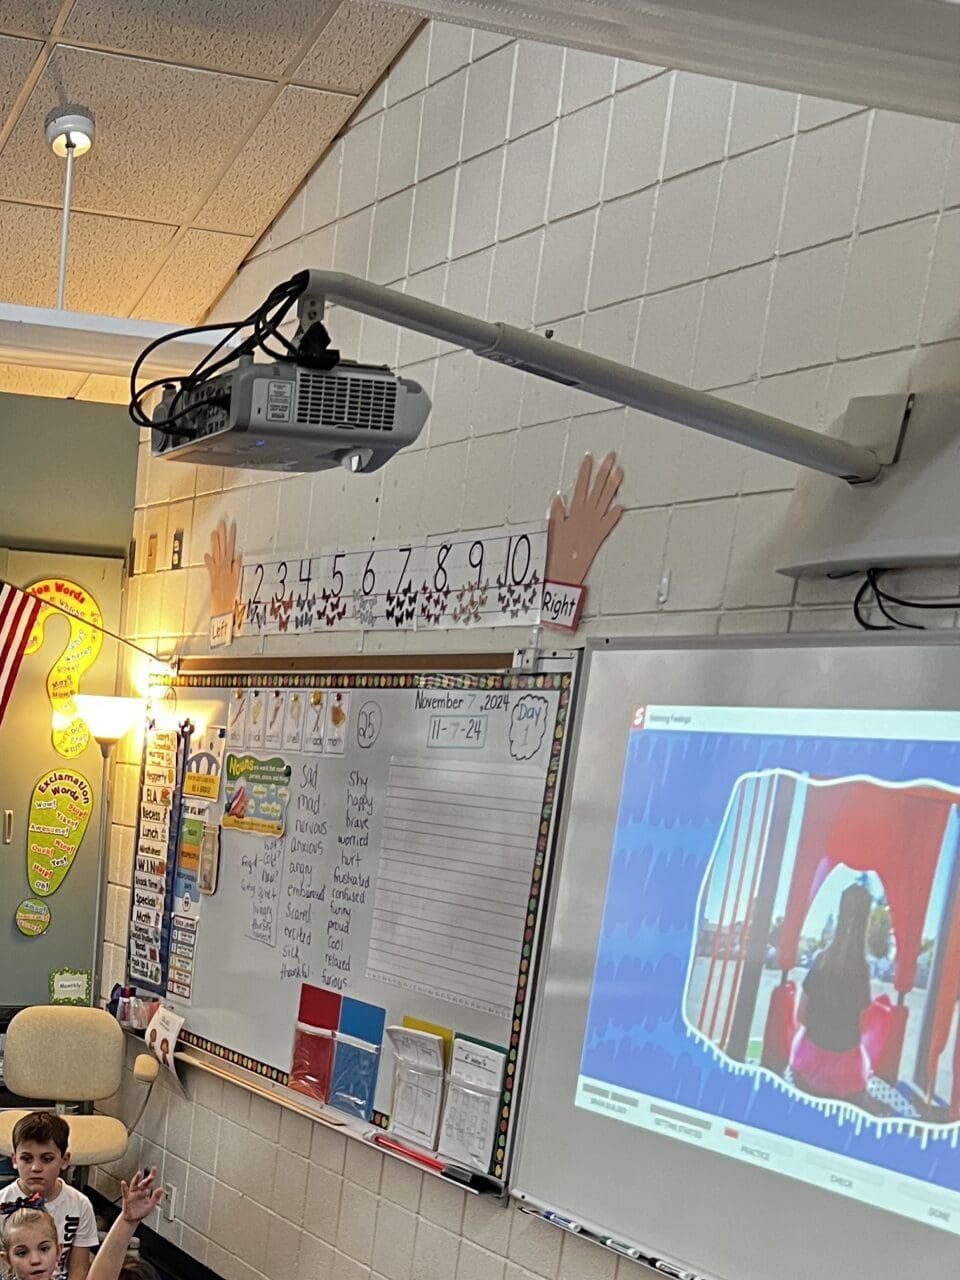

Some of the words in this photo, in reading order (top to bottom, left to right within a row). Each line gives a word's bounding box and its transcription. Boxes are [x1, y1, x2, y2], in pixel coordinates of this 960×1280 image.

[252, 563, 264, 604] 2
[274, 561, 288, 602] 3
[299, 558, 312, 601] 4
[331, 553, 346, 598] 5
[362, 551, 376, 596] 6
[395, 547, 412, 594] 7
[433, 543, 452, 592] 8
[468, 540, 484, 590] 9
[504, 534, 531, 586] 10
[54, 581, 87, 605] Words
[543, 590, 576, 620] Right
[212, 619, 228, 640] Left
[414, 690, 464, 711] November
[358, 709, 376, 740] 25
[518, 703, 542, 728] Day
[38, 772, 90, 805] Exclamation
[51, 785, 80, 802] Words
[146, 787, 158, 804] ELA
[297, 793, 321, 816] mad
[346, 789, 374, 816] happy
[142, 805, 161, 822] Recess
[345, 810, 369, 830] brave
[142, 826, 159, 840] Lunch
[295, 818, 328, 836] nervous
[338, 830, 369, 847] worried
[341, 850, 363, 866] hurt
[289, 861, 313, 887] angry
[331, 887, 366, 905] confused
[135, 910, 152, 924] Math
[329, 901, 352, 921] funny
[326, 919, 350, 935] proud
[829, 1174, 854, 1190] CHECK
[928, 1207, 951, 1222] DONE
